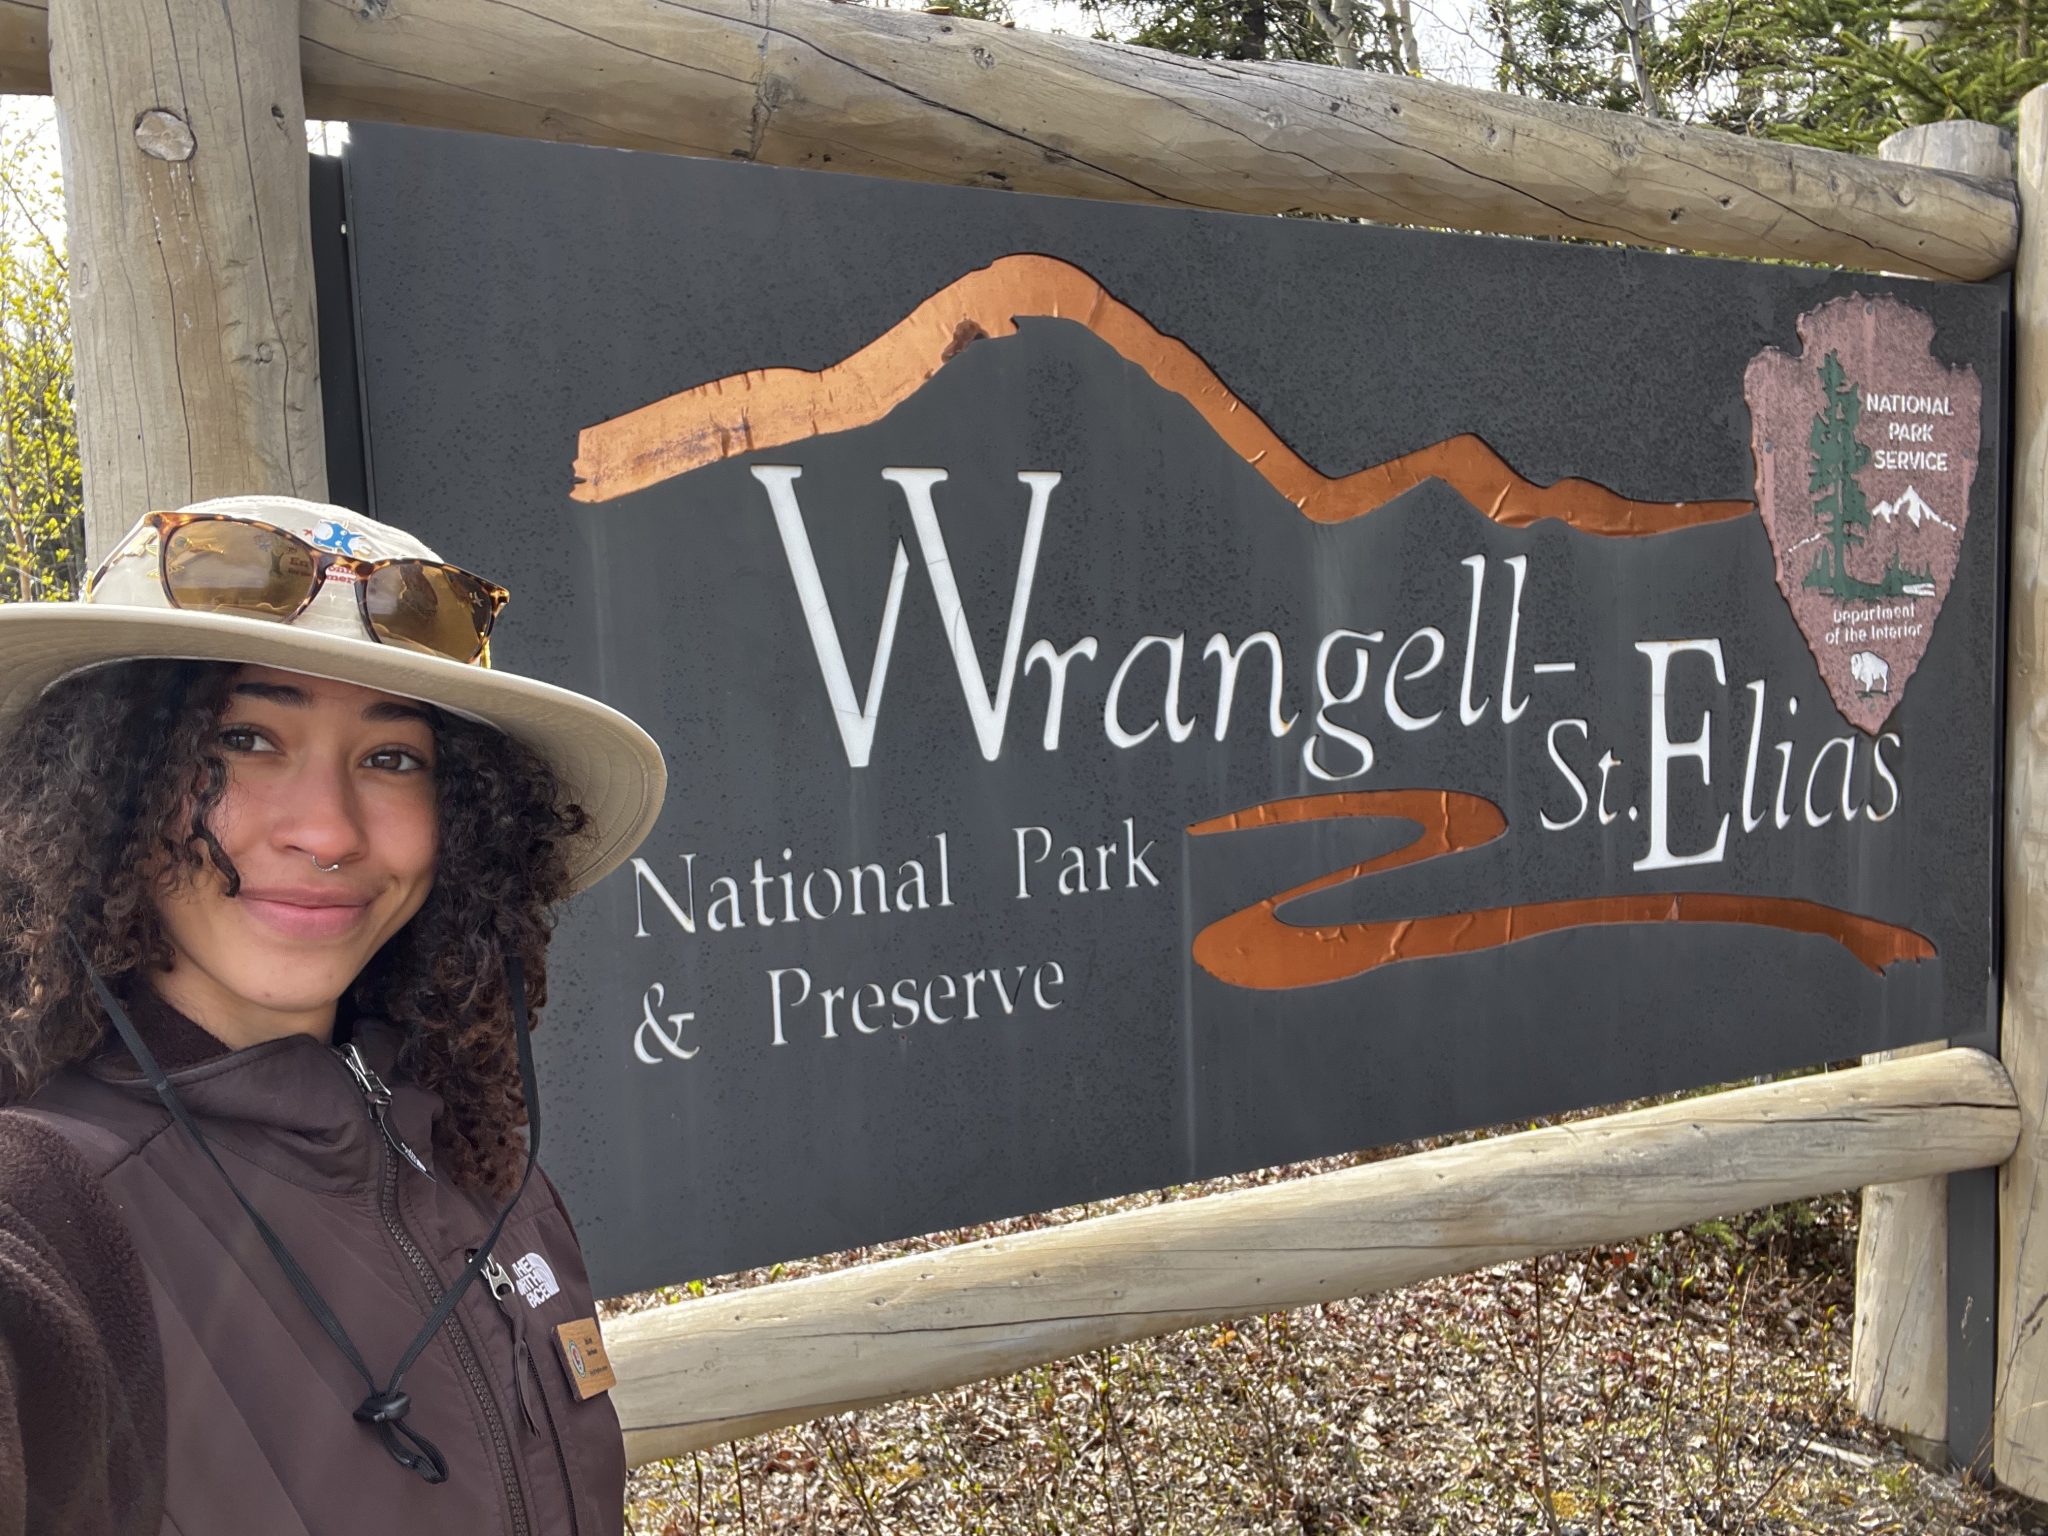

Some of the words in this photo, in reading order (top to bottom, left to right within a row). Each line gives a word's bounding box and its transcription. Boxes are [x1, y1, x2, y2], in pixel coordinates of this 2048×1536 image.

[1866, 393, 1954, 416] NATIONAL
[1888, 422, 1934, 442] PARK
[1874, 449, 1948, 471] SERVICE
[750, 464, 1576, 781] Wrangell-
[1833, 602, 1914, 626] Department
[1825, 627, 1840, 645] of
[1844, 627, 1867, 642] the
[1871, 621, 1922, 640] Interior
[1540, 718, 1638, 831] St.
[1633, 638, 1900, 872] Elias
[630, 831, 955, 938] National
[1012, 817, 1161, 899] Park
[633, 982, 700, 1064] &
[767, 961, 1065, 1046] Preserve
